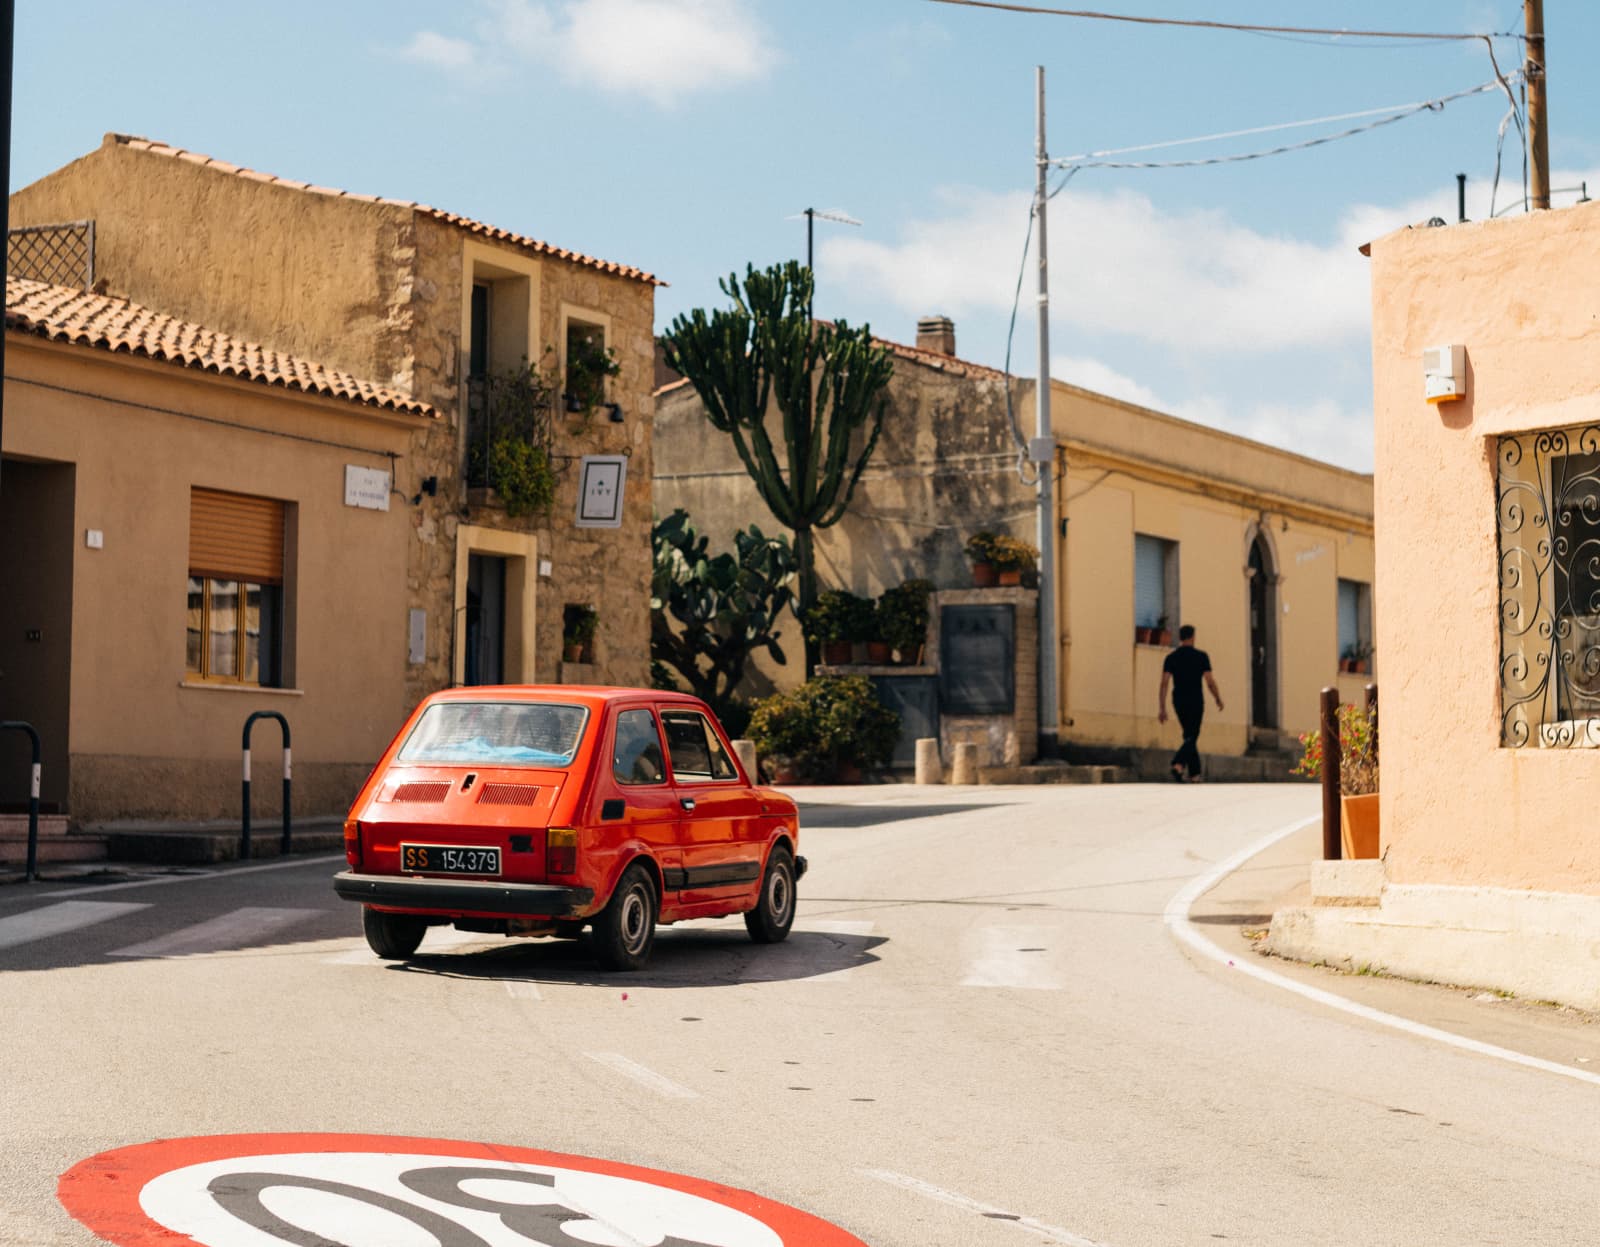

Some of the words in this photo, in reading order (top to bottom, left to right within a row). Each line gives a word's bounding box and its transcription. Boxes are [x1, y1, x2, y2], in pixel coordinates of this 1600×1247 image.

[591, 488, 610, 496] IVY
[406, 848, 428, 867] SS
[441, 850, 497, 871] 154379
